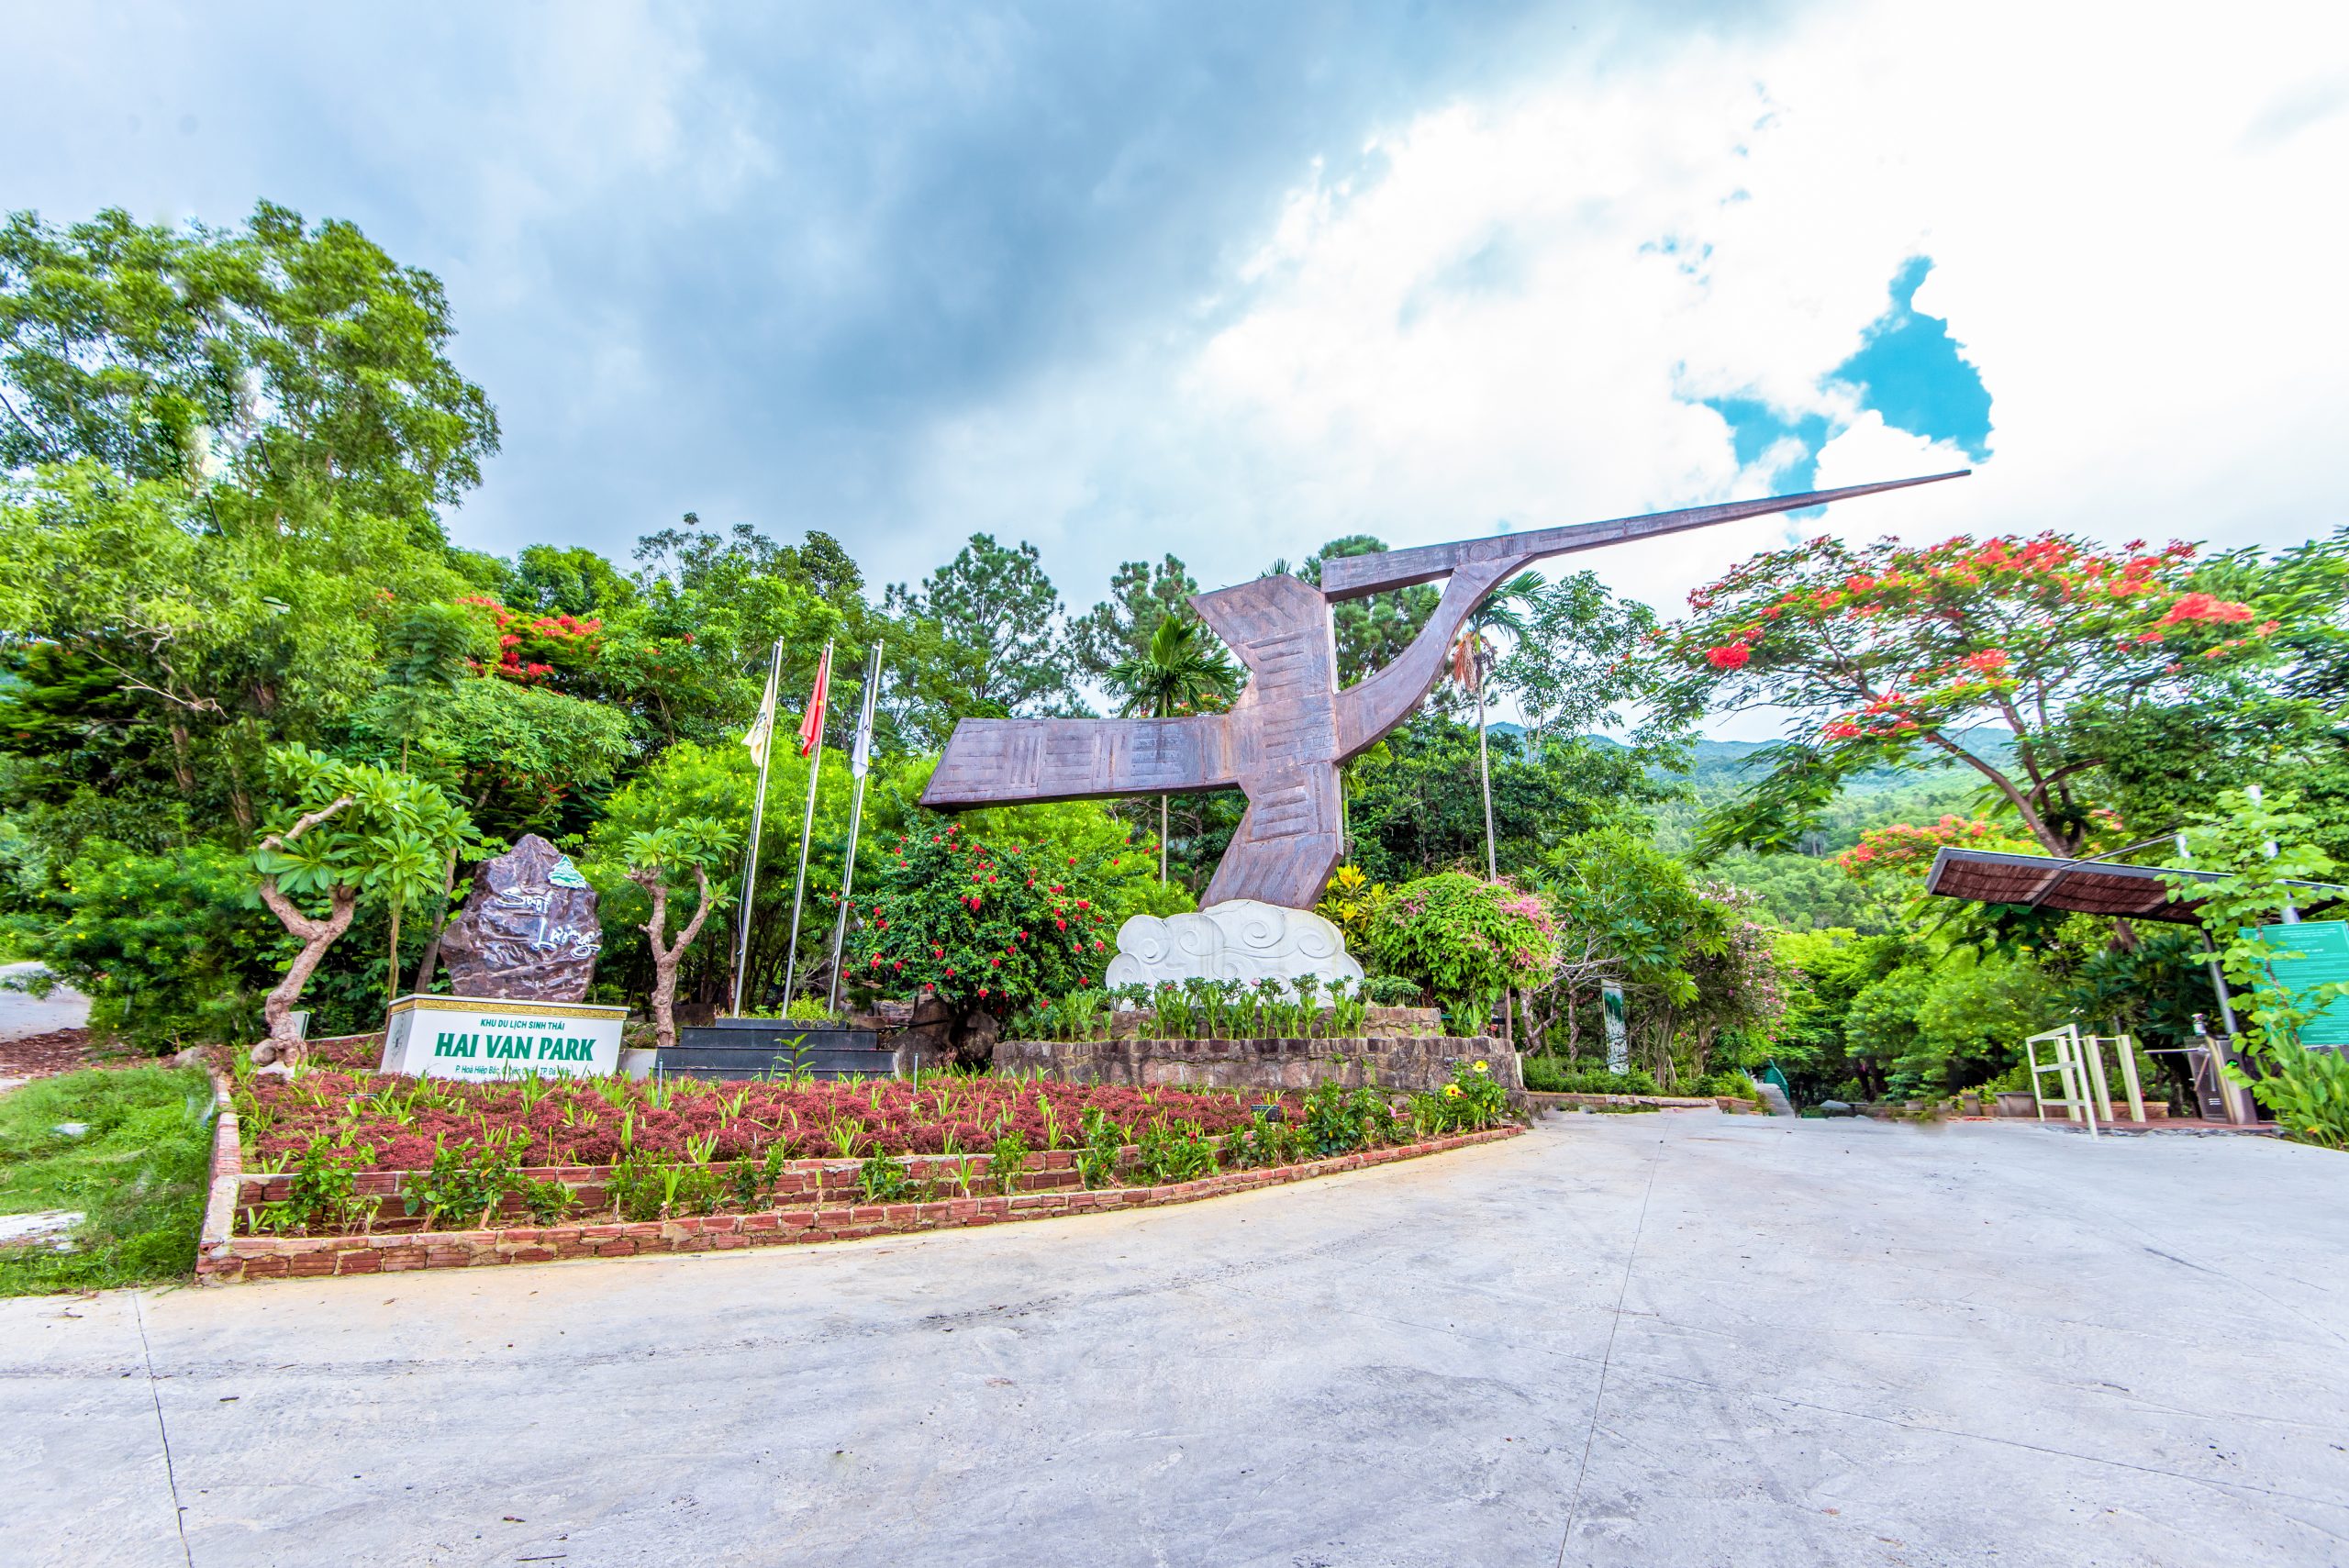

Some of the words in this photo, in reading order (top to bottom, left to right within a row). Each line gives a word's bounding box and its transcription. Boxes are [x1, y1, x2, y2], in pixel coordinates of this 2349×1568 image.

[480, 1018, 496, 1028] KHU
[498, 1019, 508, 1028] DU
[510, 1020, 527, 1029] LỊCH
[529, 1021, 546, 1029] SINH
[548, 1020, 565, 1030] THÁI
[434, 1032, 480, 1058] HAI
[485, 1035, 533, 1059] VAN
[537, 1037, 596, 1062] PARK
